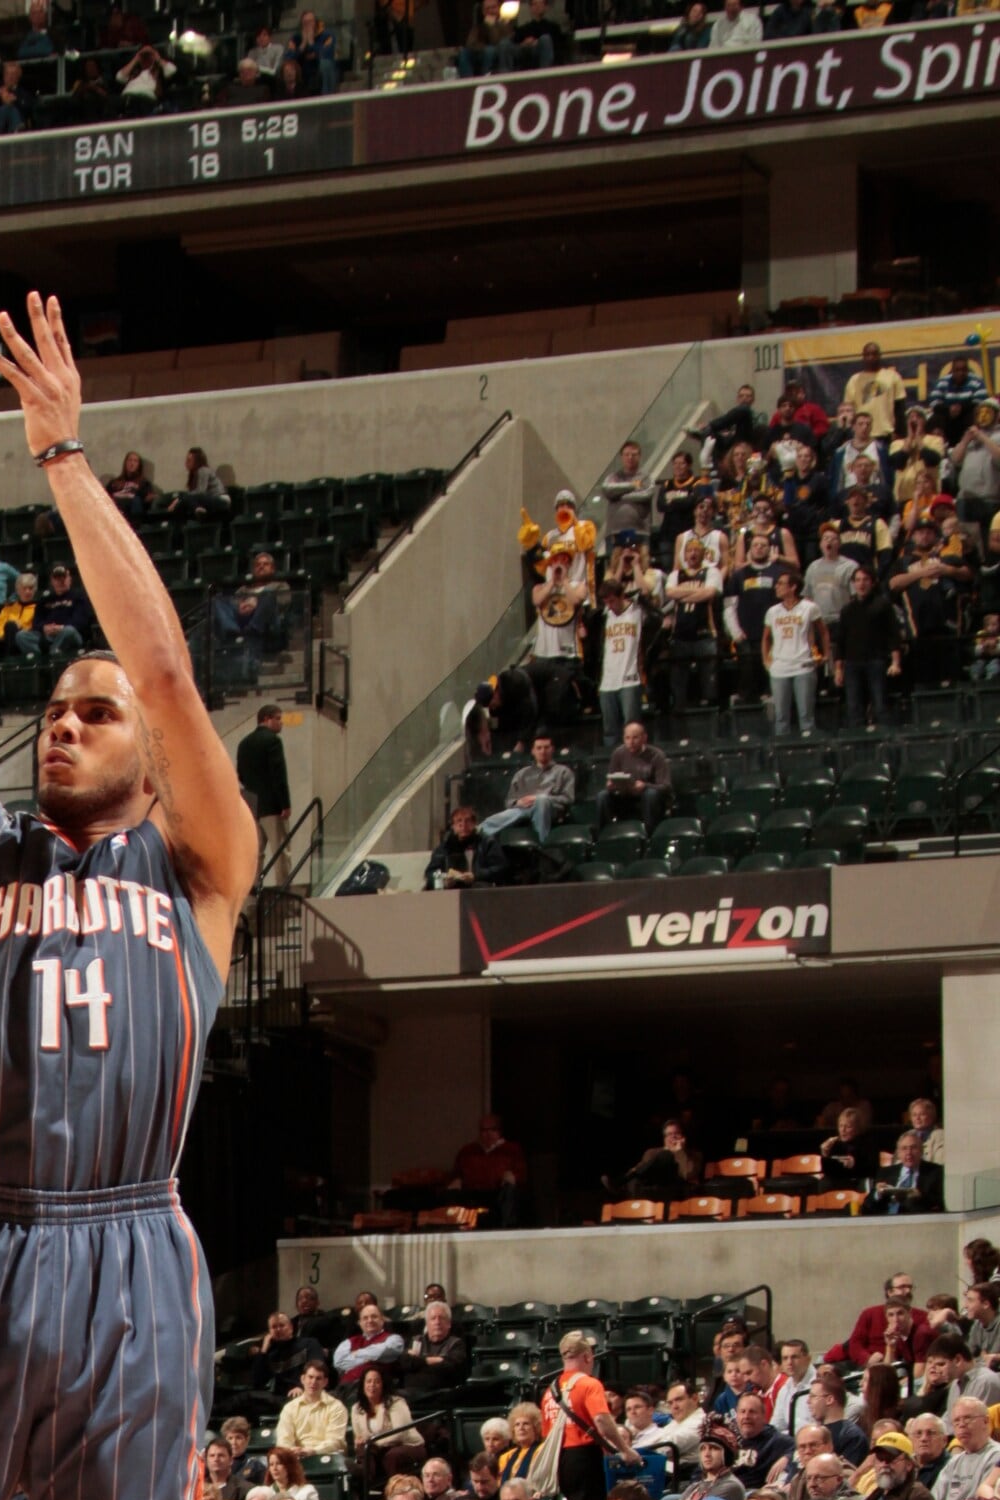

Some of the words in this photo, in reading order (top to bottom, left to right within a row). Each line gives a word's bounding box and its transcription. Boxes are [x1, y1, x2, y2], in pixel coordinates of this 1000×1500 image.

[465, 84, 649, 149] Bone,
[665, 49, 854, 127] Joint,
[74, 132, 134, 162] SAN
[73, 163, 132, 192] TOR
[263, 147, 275, 171] 1
[755, 343, 781, 373] 101
[479, 374, 489, 401] 2
[605, 621, 638, 641] ACERS
[627, 897, 829, 949] verizon
[32, 957, 113, 1051] 14
[309, 1252, 321, 1285] 3
